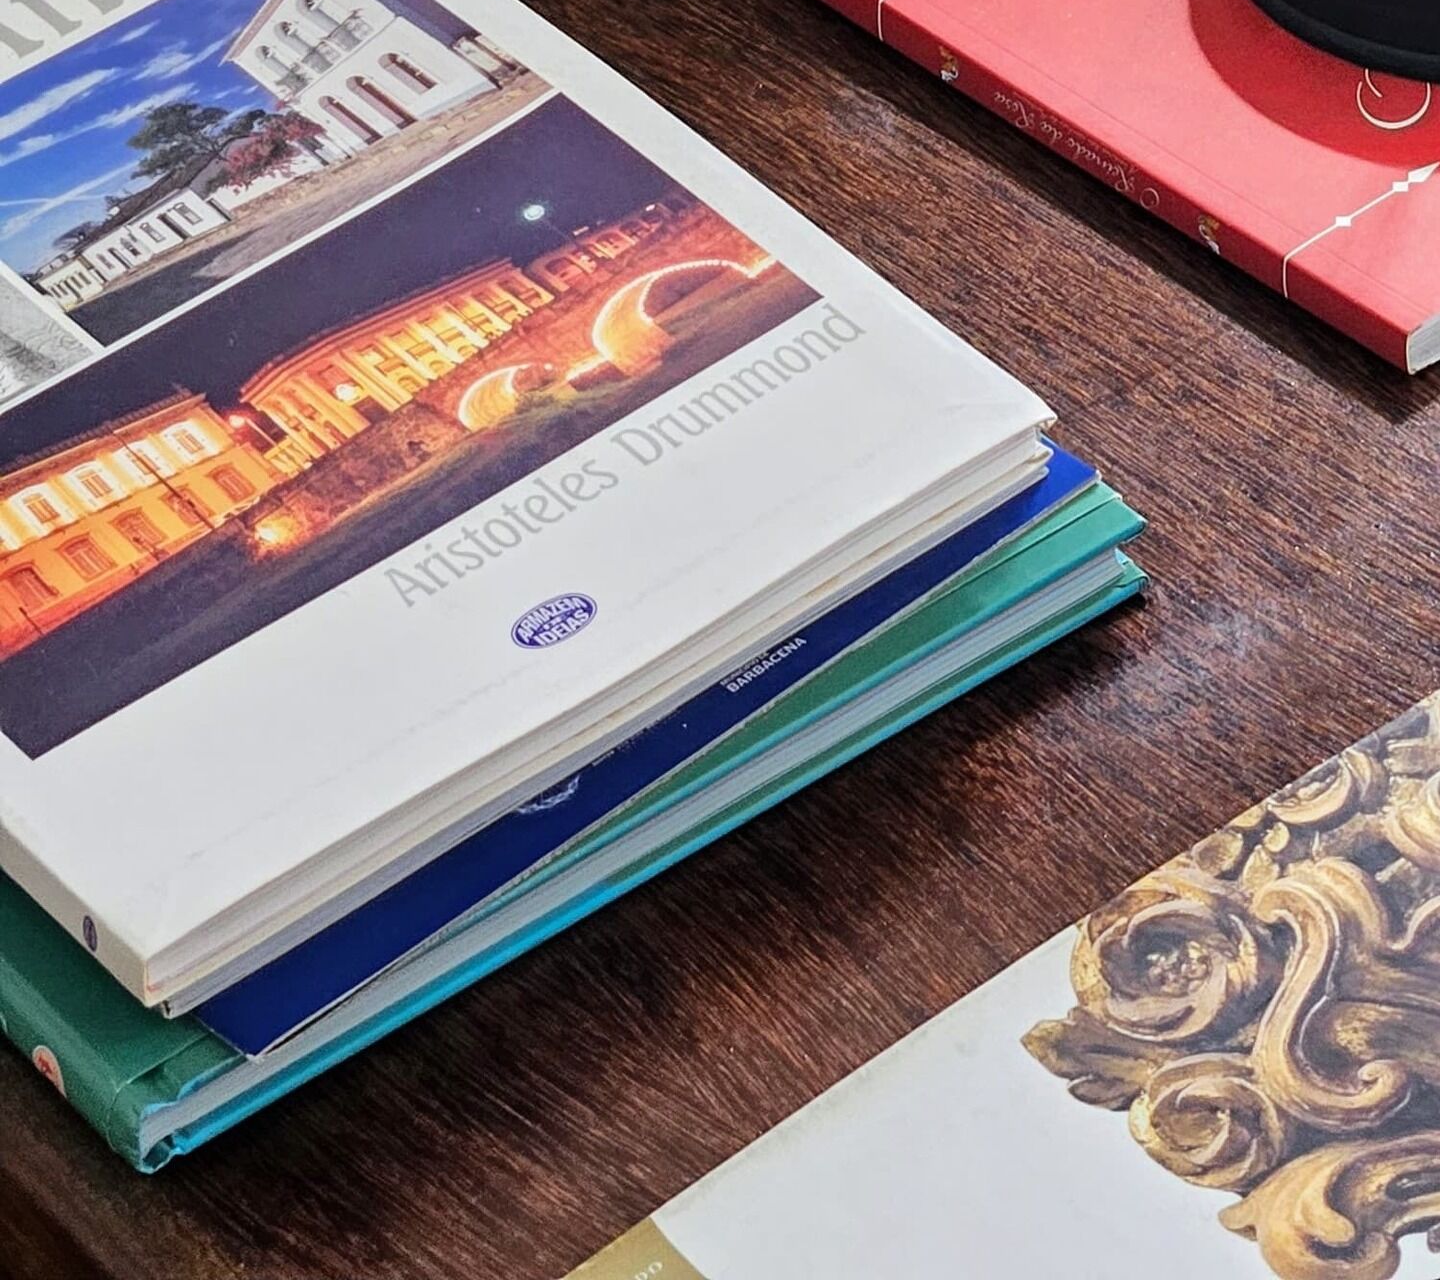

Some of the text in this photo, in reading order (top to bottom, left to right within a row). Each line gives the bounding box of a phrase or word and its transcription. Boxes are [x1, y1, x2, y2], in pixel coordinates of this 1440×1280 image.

[383, 301, 867, 608] Aristoteles Drummond
[534, 608, 590, 648] IDEIAS
[726, 636, 808, 693] BARBACENA
